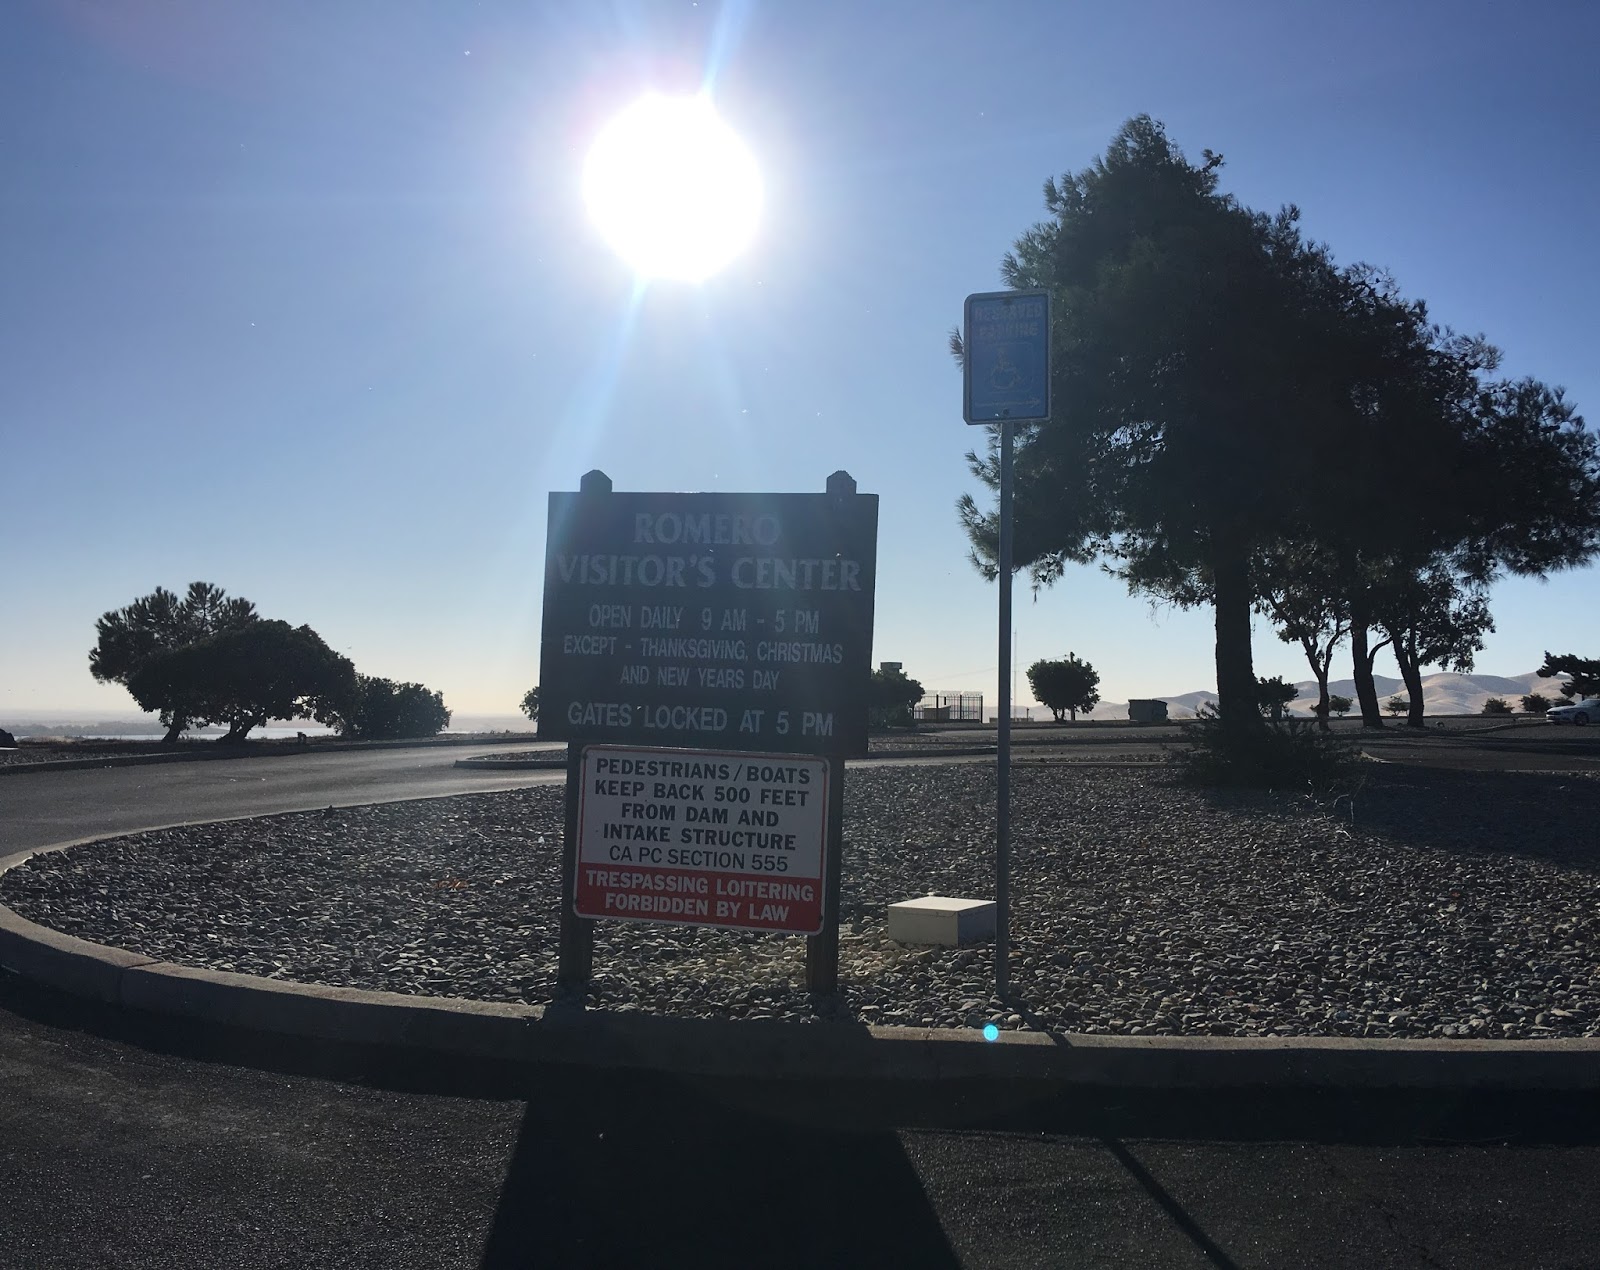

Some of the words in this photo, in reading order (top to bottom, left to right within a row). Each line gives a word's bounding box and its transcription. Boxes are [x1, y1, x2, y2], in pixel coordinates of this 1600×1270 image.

[632, 511, 781, 545] ROMERO
[555, 552, 716, 587] VISITOR'S
[731, 556, 862, 591] CENTER
[589, 604, 632, 628] OPEN
[640, 606, 684, 629] DAILY
[701, 607, 712, 631] 9
[720, 608, 747, 631] AM
[774, 609, 785, 633] 5
[795, 610, 819, 634] PM
[563, 635, 617, 655] EXCEPT
[640, 637, 749, 662] THANKSGIVING,
[757, 641, 843, 664] CHRISTMAS
[620, 665, 650, 685] AND
[657, 667, 690, 686] NEW
[698, 667, 745, 689] YEARS
[753, 670, 780, 690] DAY
[567, 701, 632, 727] GATES
[643, 705, 728, 731] LOCKED
[739, 709, 765, 733] AT
[776, 710, 790, 735] 5
[802, 711, 834, 736] PM
[594, 779, 645, 797] KEEP
[653, 782, 705, 801] BACK
[714, 786, 750, 803] 500
[760, 788, 810, 807] FEET
[621, 802, 676, 821] FROM
[685, 806, 728, 824] DAM
[738, 809, 779, 827] AND
[603, 823, 671, 842] INTAKE
[681, 828, 796, 851] STRUCTURE
[609, 845, 633, 862] CA
[638, 847, 662, 864] PC
[667, 849, 745, 870] SECTION
[751, 854, 789, 872] 555
[586, 869, 709, 894] TRESPASSING
[716, 878, 814, 902] LOITERING
[605, 892, 708, 916] FORBIDDEN
[716, 900, 742, 918] BY
[750, 904, 789, 922] LAW
